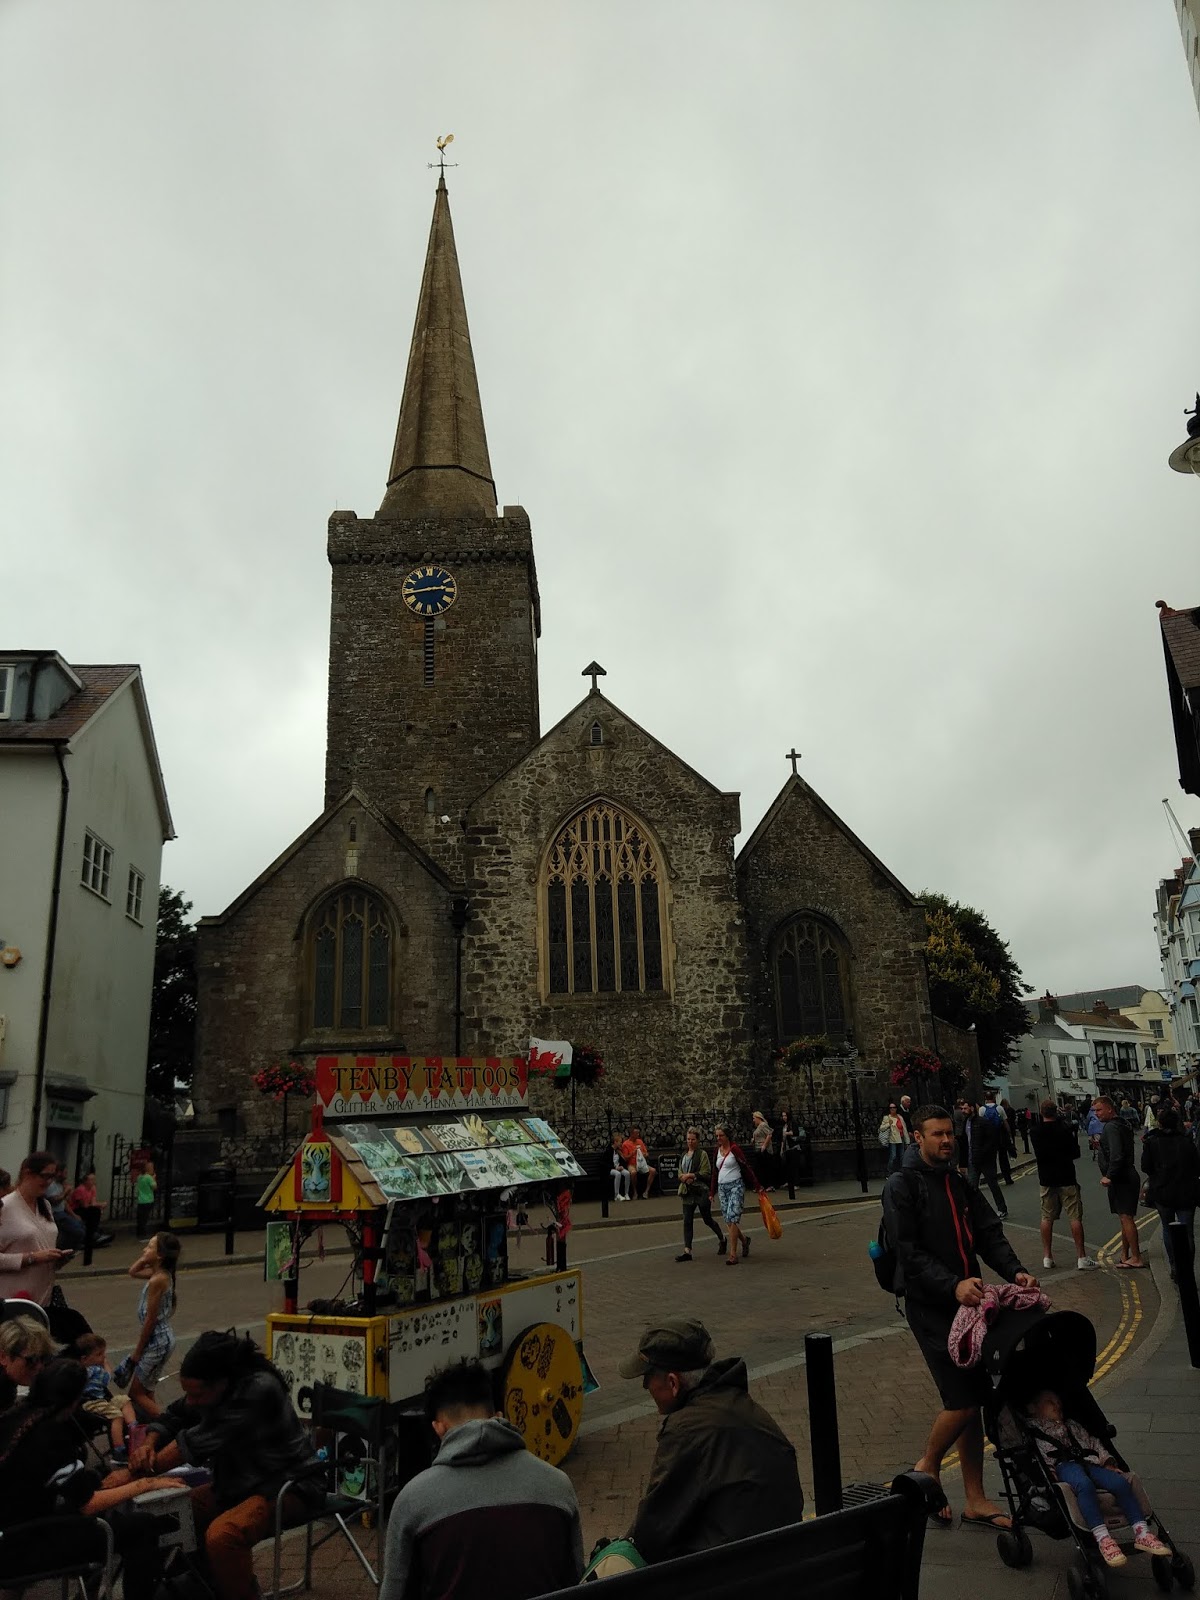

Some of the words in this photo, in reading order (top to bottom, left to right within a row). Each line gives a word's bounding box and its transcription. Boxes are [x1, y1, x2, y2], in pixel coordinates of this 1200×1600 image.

[330, 1064, 417, 1090] TENBY
[423, 1066, 520, 1088] TATTOOS
[334, 1098, 377, 1113] GLITTER
[386, 1097, 414, 1110] SPRAY
[423, 1095, 456, 1109] HENNA
[464, 1094, 487, 1107] HAIR
[489, 1094, 519, 1107] BRAIDS
[434, 1127, 467, 1139] HAIR
